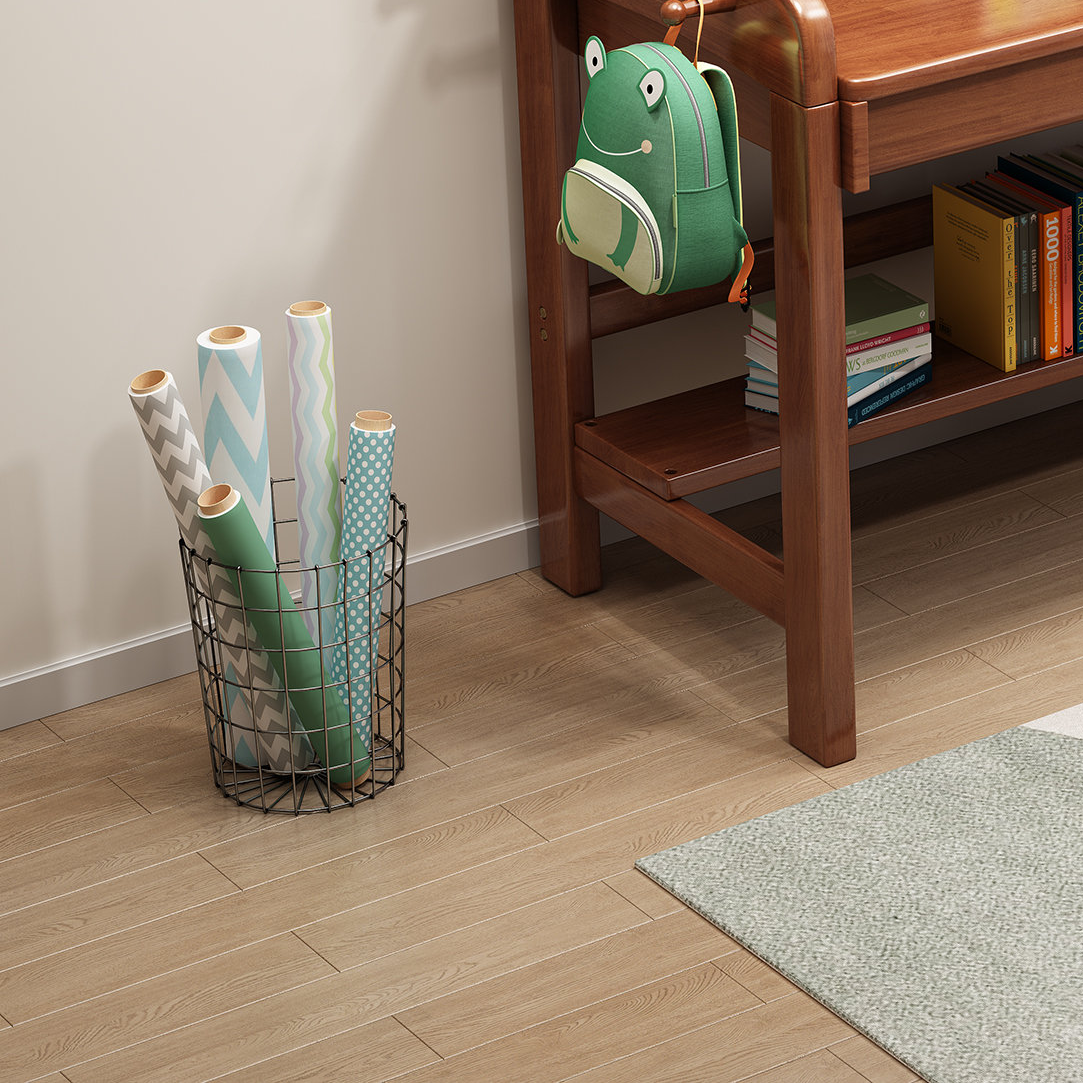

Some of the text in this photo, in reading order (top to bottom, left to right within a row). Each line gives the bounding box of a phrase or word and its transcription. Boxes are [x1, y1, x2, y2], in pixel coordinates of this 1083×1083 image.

[1046, 217, 1059, 261] 1000
[873, 337, 891, 345] WRIGHT
[907, 375, 925, 389] GRAPHIC
[890, 385, 906, 399] DESIGN
